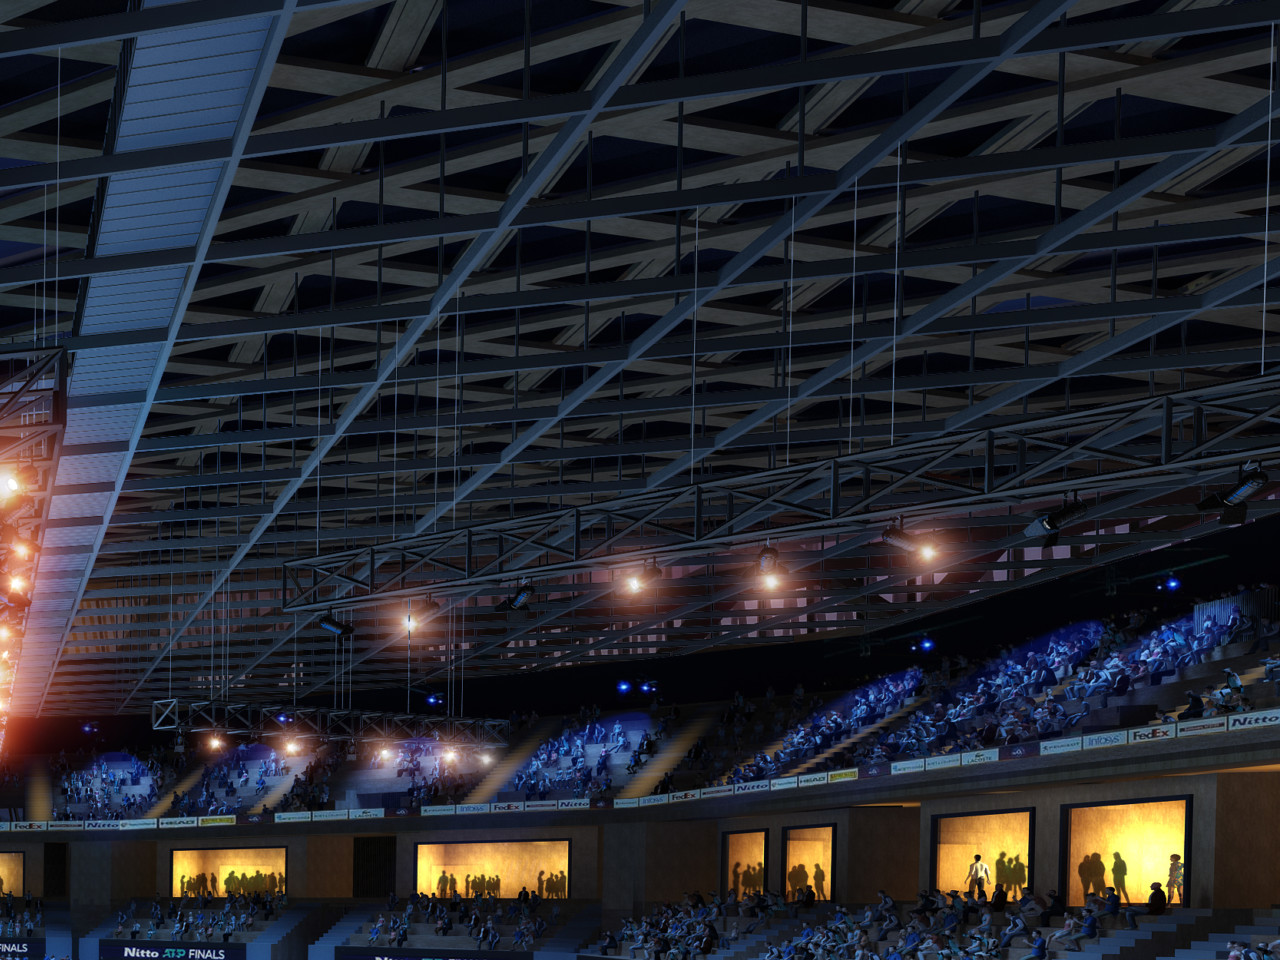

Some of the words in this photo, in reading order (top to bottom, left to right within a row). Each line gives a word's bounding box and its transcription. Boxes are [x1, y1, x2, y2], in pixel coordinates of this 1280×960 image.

[1232, 711, 1279, 727] Nitto
[1133, 729, 1169, 740] FedEx
[1088, 735, 1120, 746] Infosys
[799, 776, 826, 784] HEAD
[737, 783, 768, 792] Nitto
[672, 792, 696, 801] FedEx
[494, 803, 519, 811] FedEx
[124, 947, 159, 958] Nitto
[162, 948, 186, 958] ATP
[188, 949, 225, 959] FINALS
